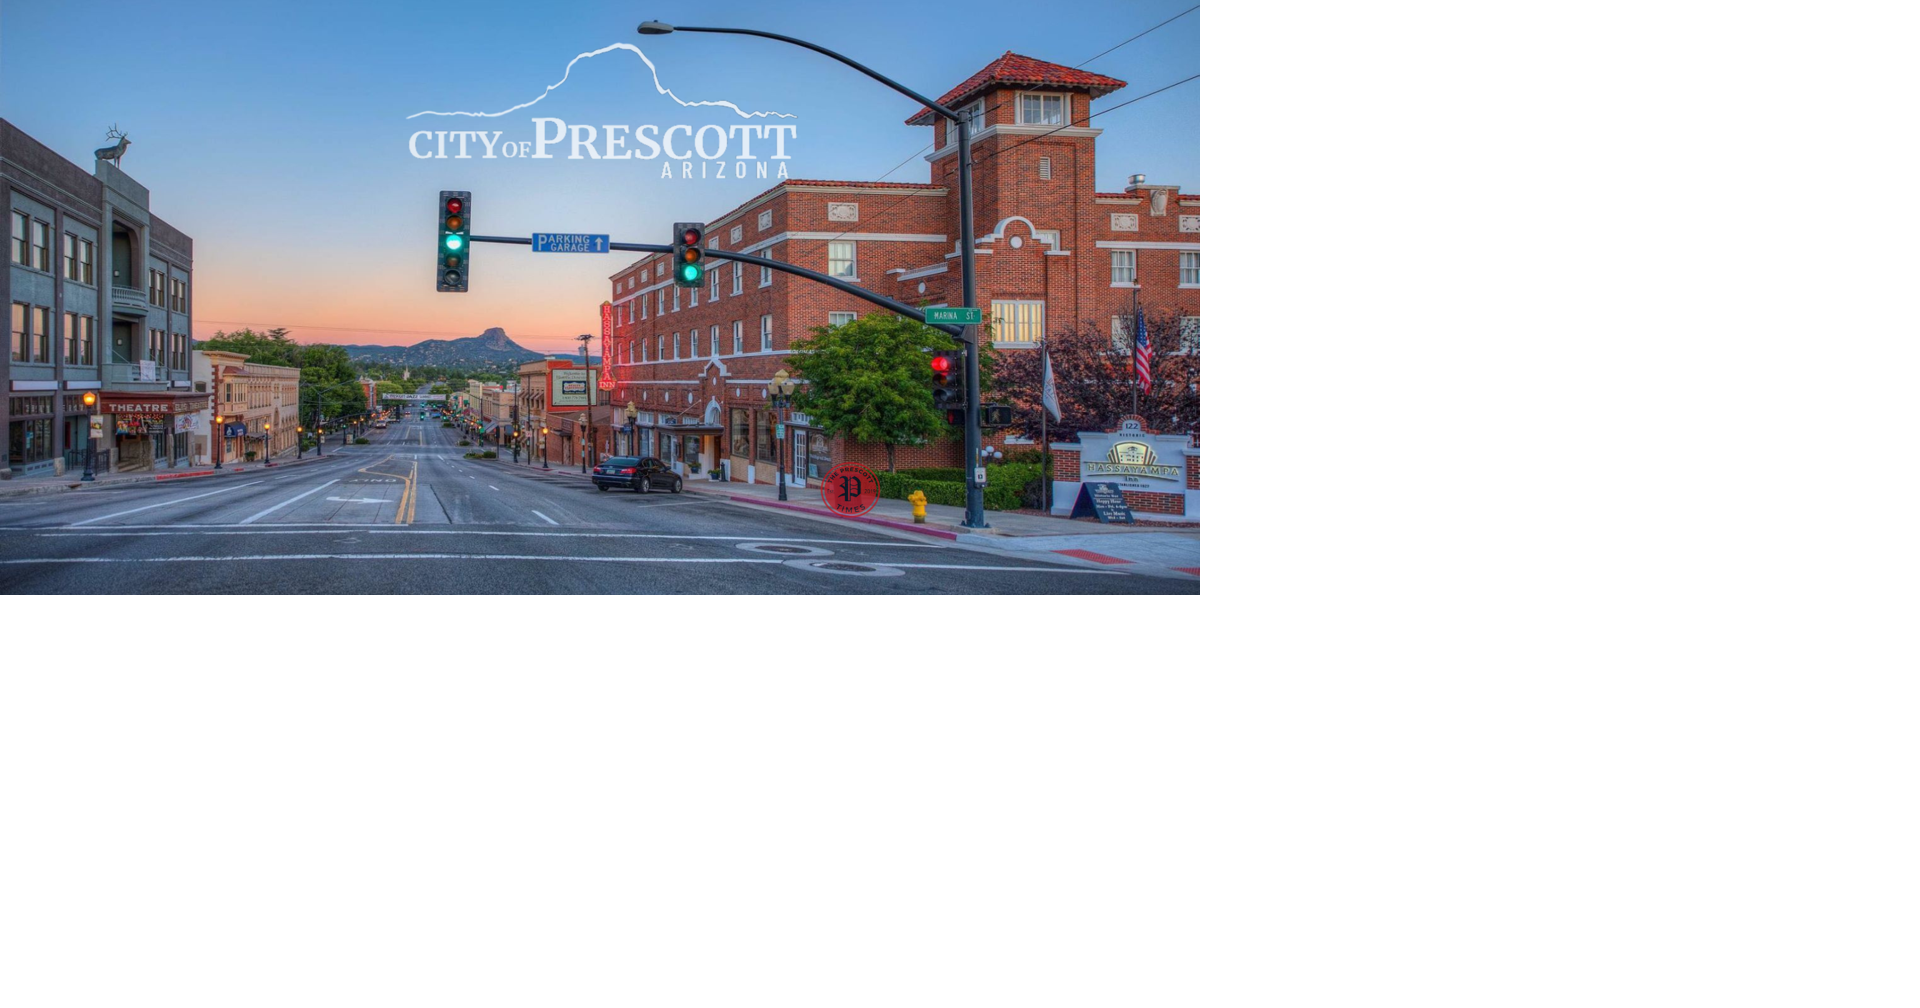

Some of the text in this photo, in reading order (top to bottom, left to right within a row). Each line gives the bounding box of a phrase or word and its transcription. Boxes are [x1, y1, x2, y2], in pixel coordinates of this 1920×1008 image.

[538, 234, 590, 251] PARKING
[550, 243, 590, 252] GARAGE
[934, 311, 958, 320] MARINA
[602, 305, 612, 380] HASSAYAMPA
[599, 381, 616, 389] INN
[108, 403, 169, 412] THEATRE
[1087, 462, 1179, 476] HASSAYAMPA
